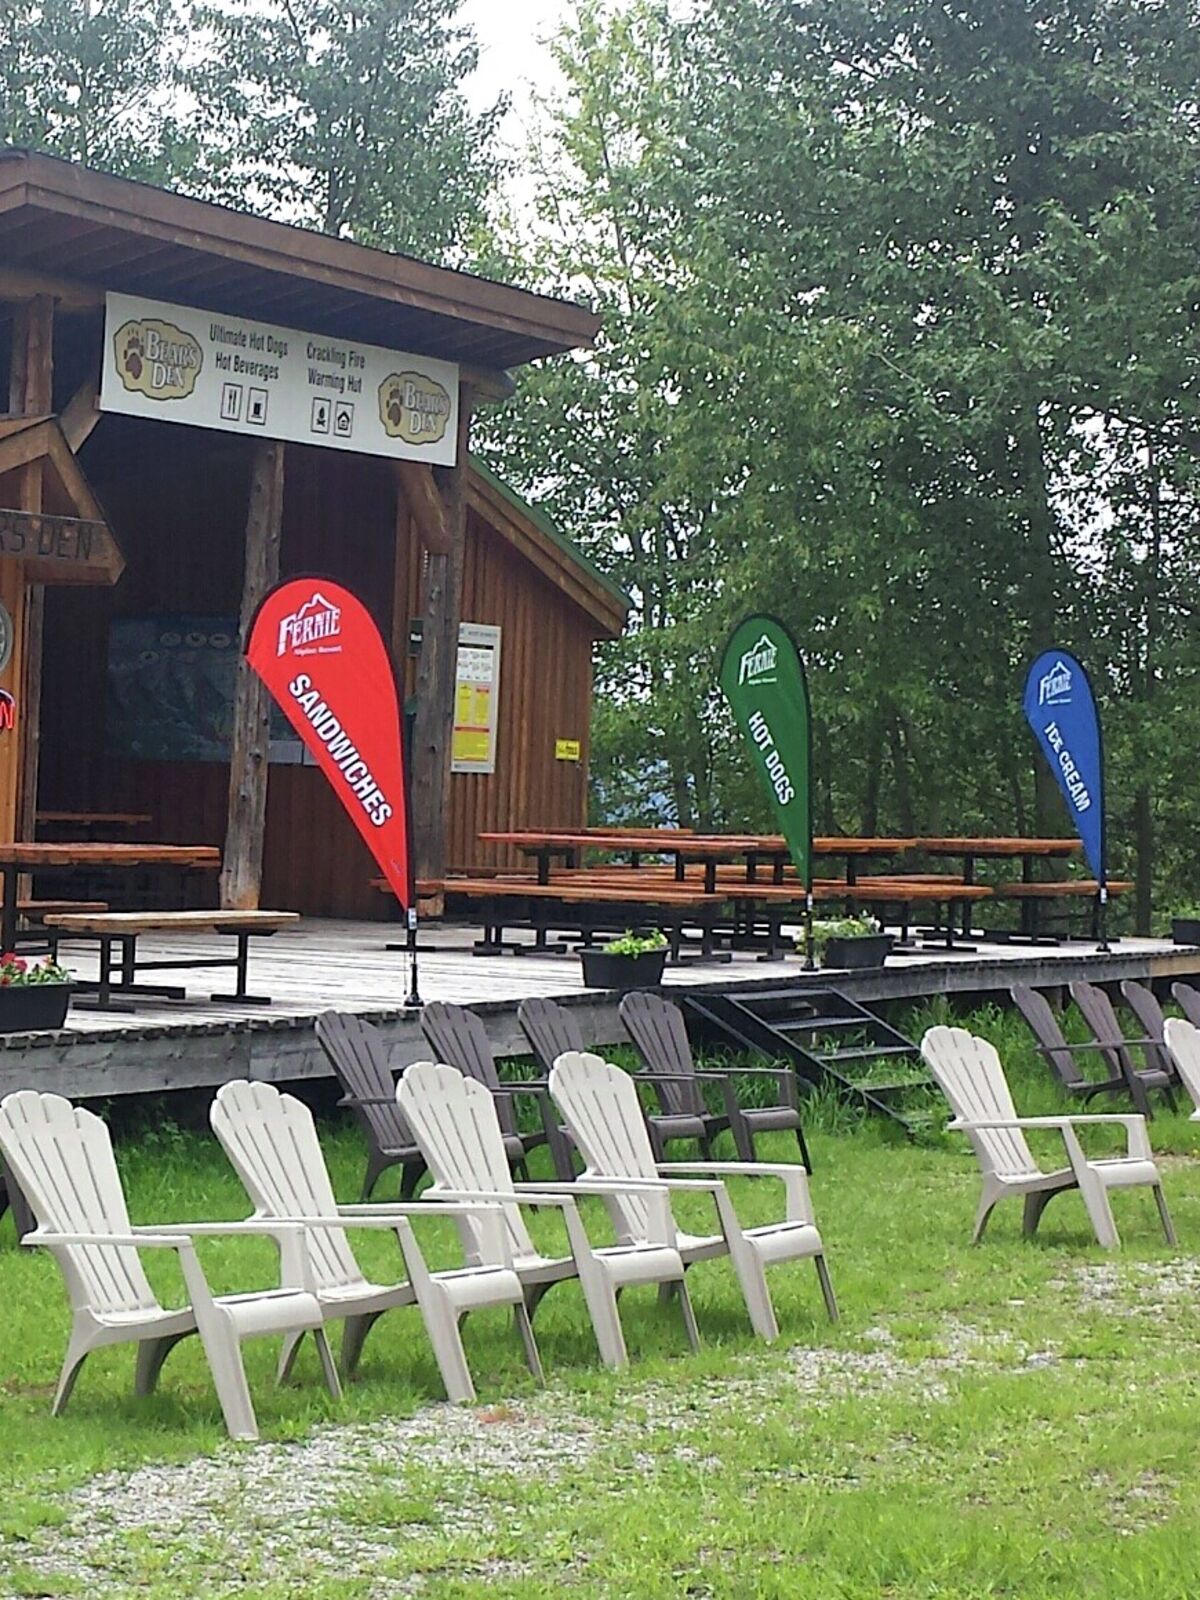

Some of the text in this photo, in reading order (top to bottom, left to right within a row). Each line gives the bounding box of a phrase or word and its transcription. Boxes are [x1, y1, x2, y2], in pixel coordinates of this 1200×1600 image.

[209, 323, 289, 358] Ultimate Hot Dogs
[306, 342, 366, 369] Crackling Fire
[152, 362, 185, 389] DEN
[215, 352, 280, 382] Hot Beverages
[307, 367, 363, 394] Warming Hut
[37, 516, 95, 562] DEN
[277, 608, 341, 657] FERNIE
[289, 674, 393, 827] SANDWICHES
[748, 711, 775, 752] HOT
[764, 749, 796, 805] DOGS
[1043, 721, 1064, 754] ICE
[1059, 751, 1092, 813] CREAM
